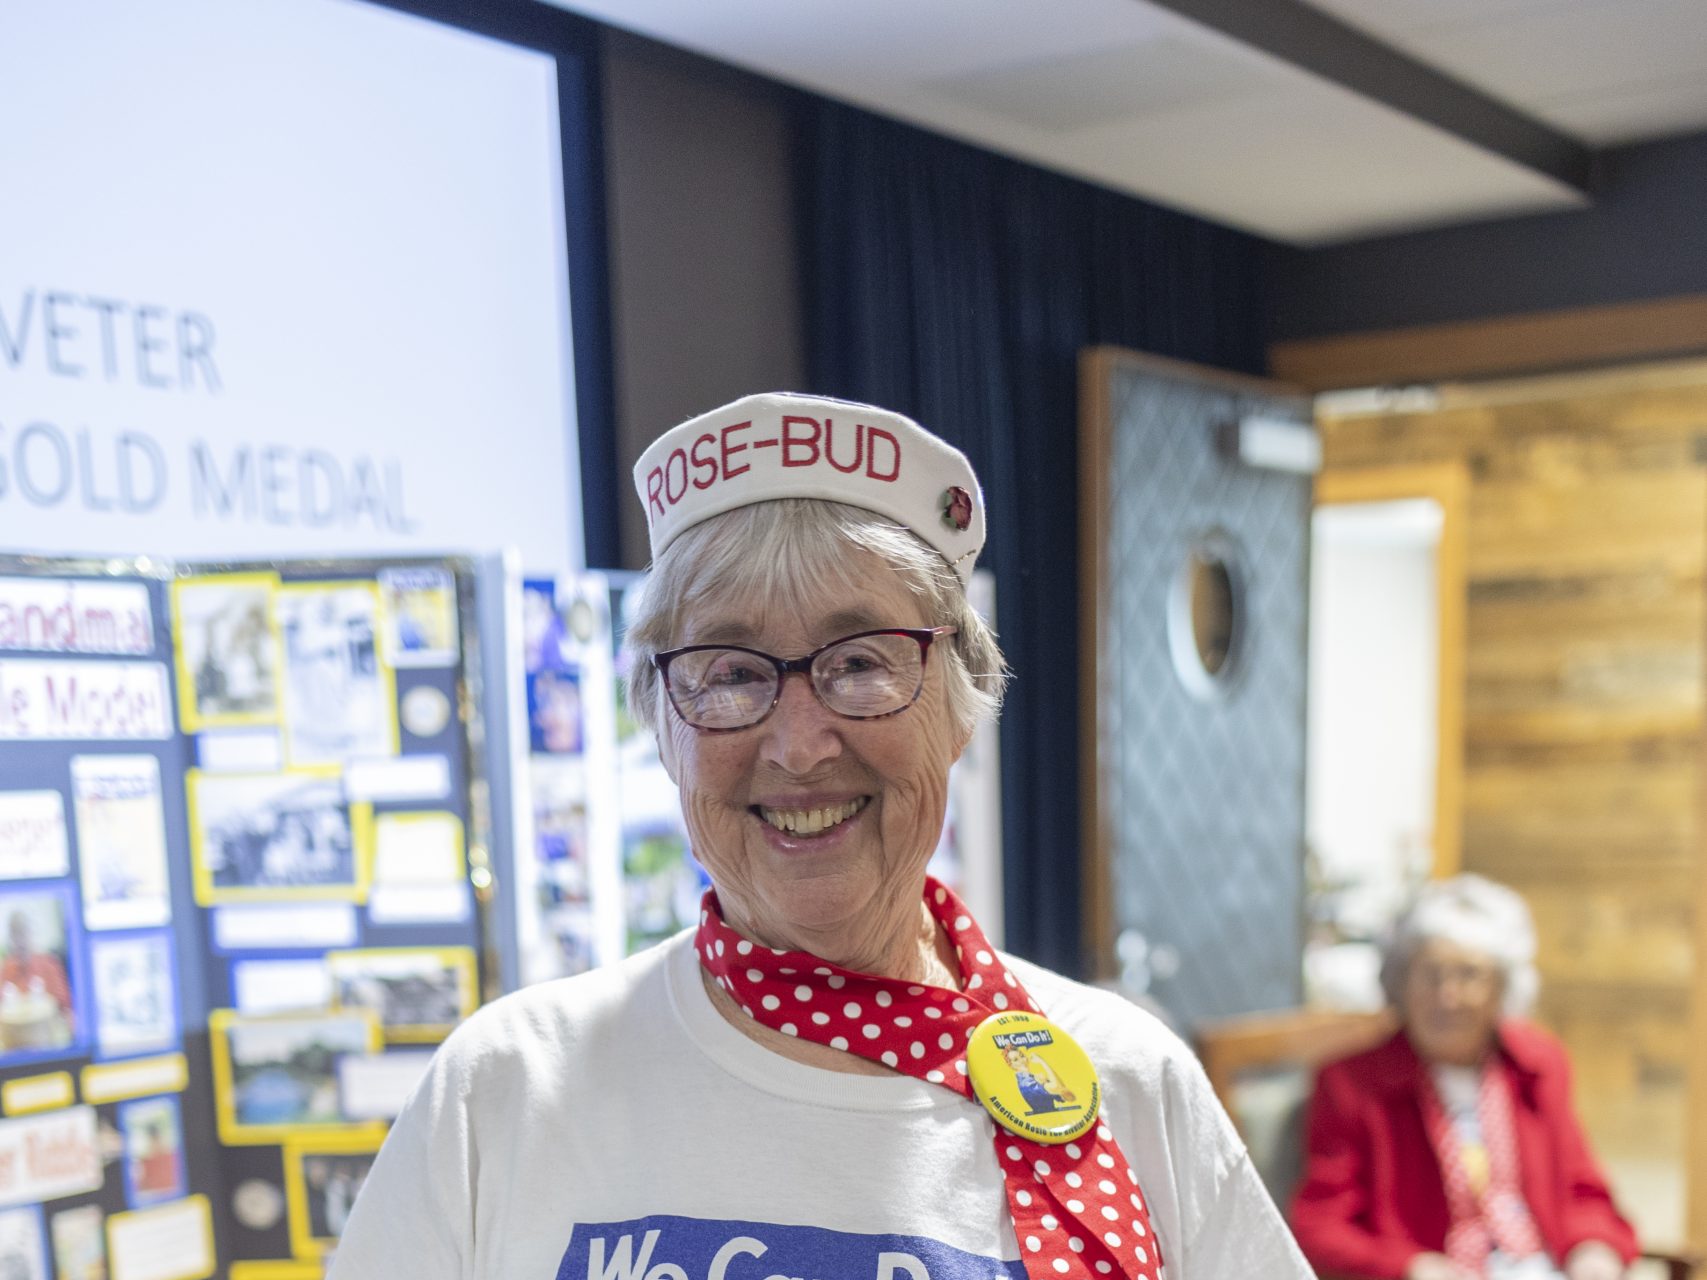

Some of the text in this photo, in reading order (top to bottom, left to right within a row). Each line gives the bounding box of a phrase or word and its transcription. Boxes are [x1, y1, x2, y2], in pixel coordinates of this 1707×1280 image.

[0, 286, 223, 396] VETER
[189, 436, 418, 536] MEDAL
[646, 414, 901, 528] ROSE-BUD
[994, 1029, 1052, 1048] We Can Do It!
[989, 1096, 1024, 1128] American
[1025, 1122, 1047, 1136] Rosie
